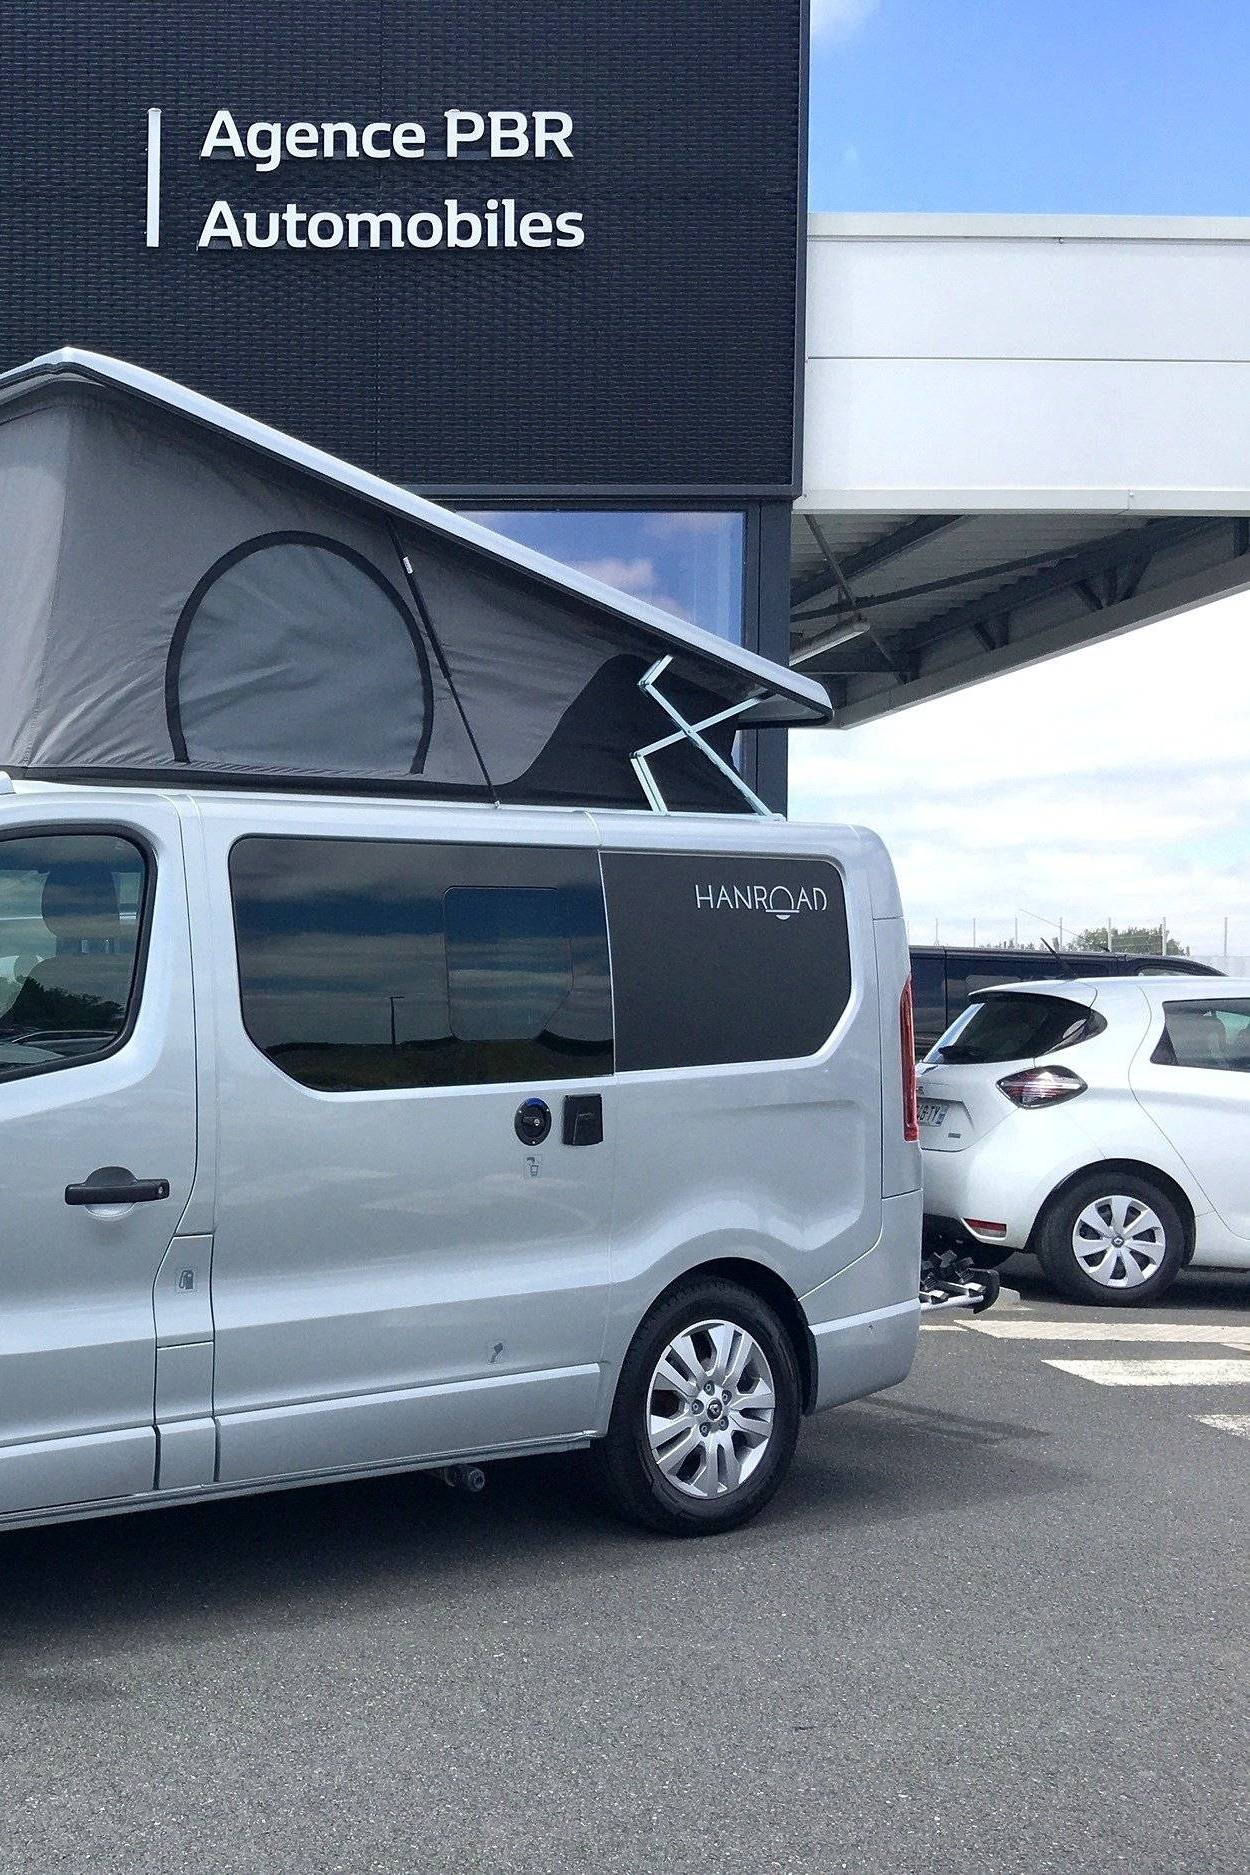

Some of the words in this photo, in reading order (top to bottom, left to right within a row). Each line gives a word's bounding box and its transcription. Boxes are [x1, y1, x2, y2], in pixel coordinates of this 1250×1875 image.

[200, 110, 426, 172] Agence
[444, 109, 574, 158] PBR
[197, 199, 585, 251] Automobiles
[695, 884, 828, 920] HANROAD
